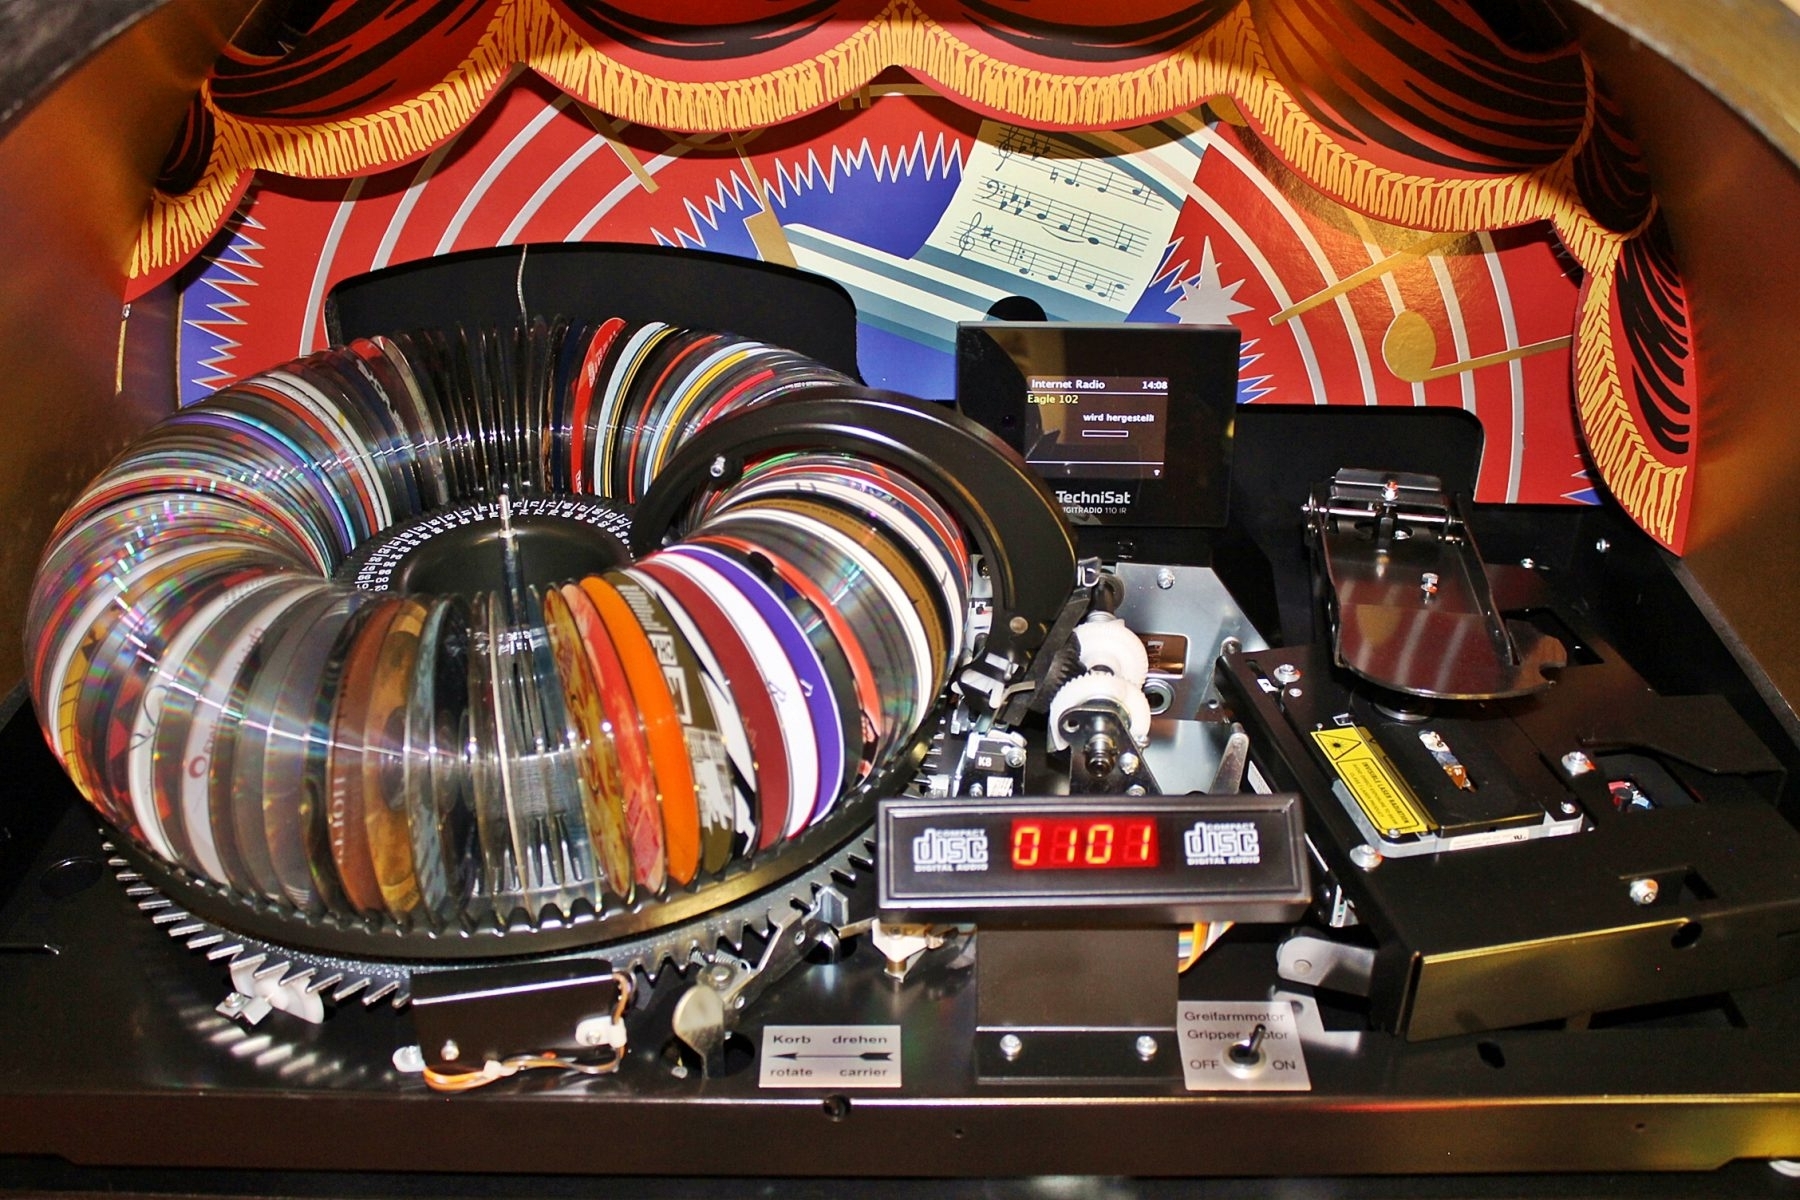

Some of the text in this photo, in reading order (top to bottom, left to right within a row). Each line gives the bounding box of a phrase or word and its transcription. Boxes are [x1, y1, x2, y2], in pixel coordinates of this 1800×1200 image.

[1031, 379, 1168, 390] Internet Radio 14:08
[1027, 394, 1079, 405] Eagle 102
[1083, 413, 1155, 424] wird hergestellt
[1055, 490, 1131, 505] TechniSat
[1062, 506, 1103, 514] IGITRADIO
[978, 756, 992, 767] K8
[1361, 762, 1381, 782] INVISIBLE
[1377, 784, 1392, 798] LASER
[1207, 822, 1255, 830] COMPACT
[936, 829, 985, 837] COMPACT
[1184, 822, 1260, 857] disc
[913, 828, 988, 864] disc
[1187, 856, 1260, 865] DIGITAL AUDIO
[914, 863, 988, 872] DIGITAL AUDIO
[1184, 1011, 1284, 1021] Greifarmmotor
[773, 1035, 887, 1044] Korb drehen
[1187, 1029, 1240, 1040] Gripper
[1190, 1060, 1219, 1070] OFF
[1272, 1060, 1296, 1070] ON
[770, 1068, 887, 1077] rotate carrier
